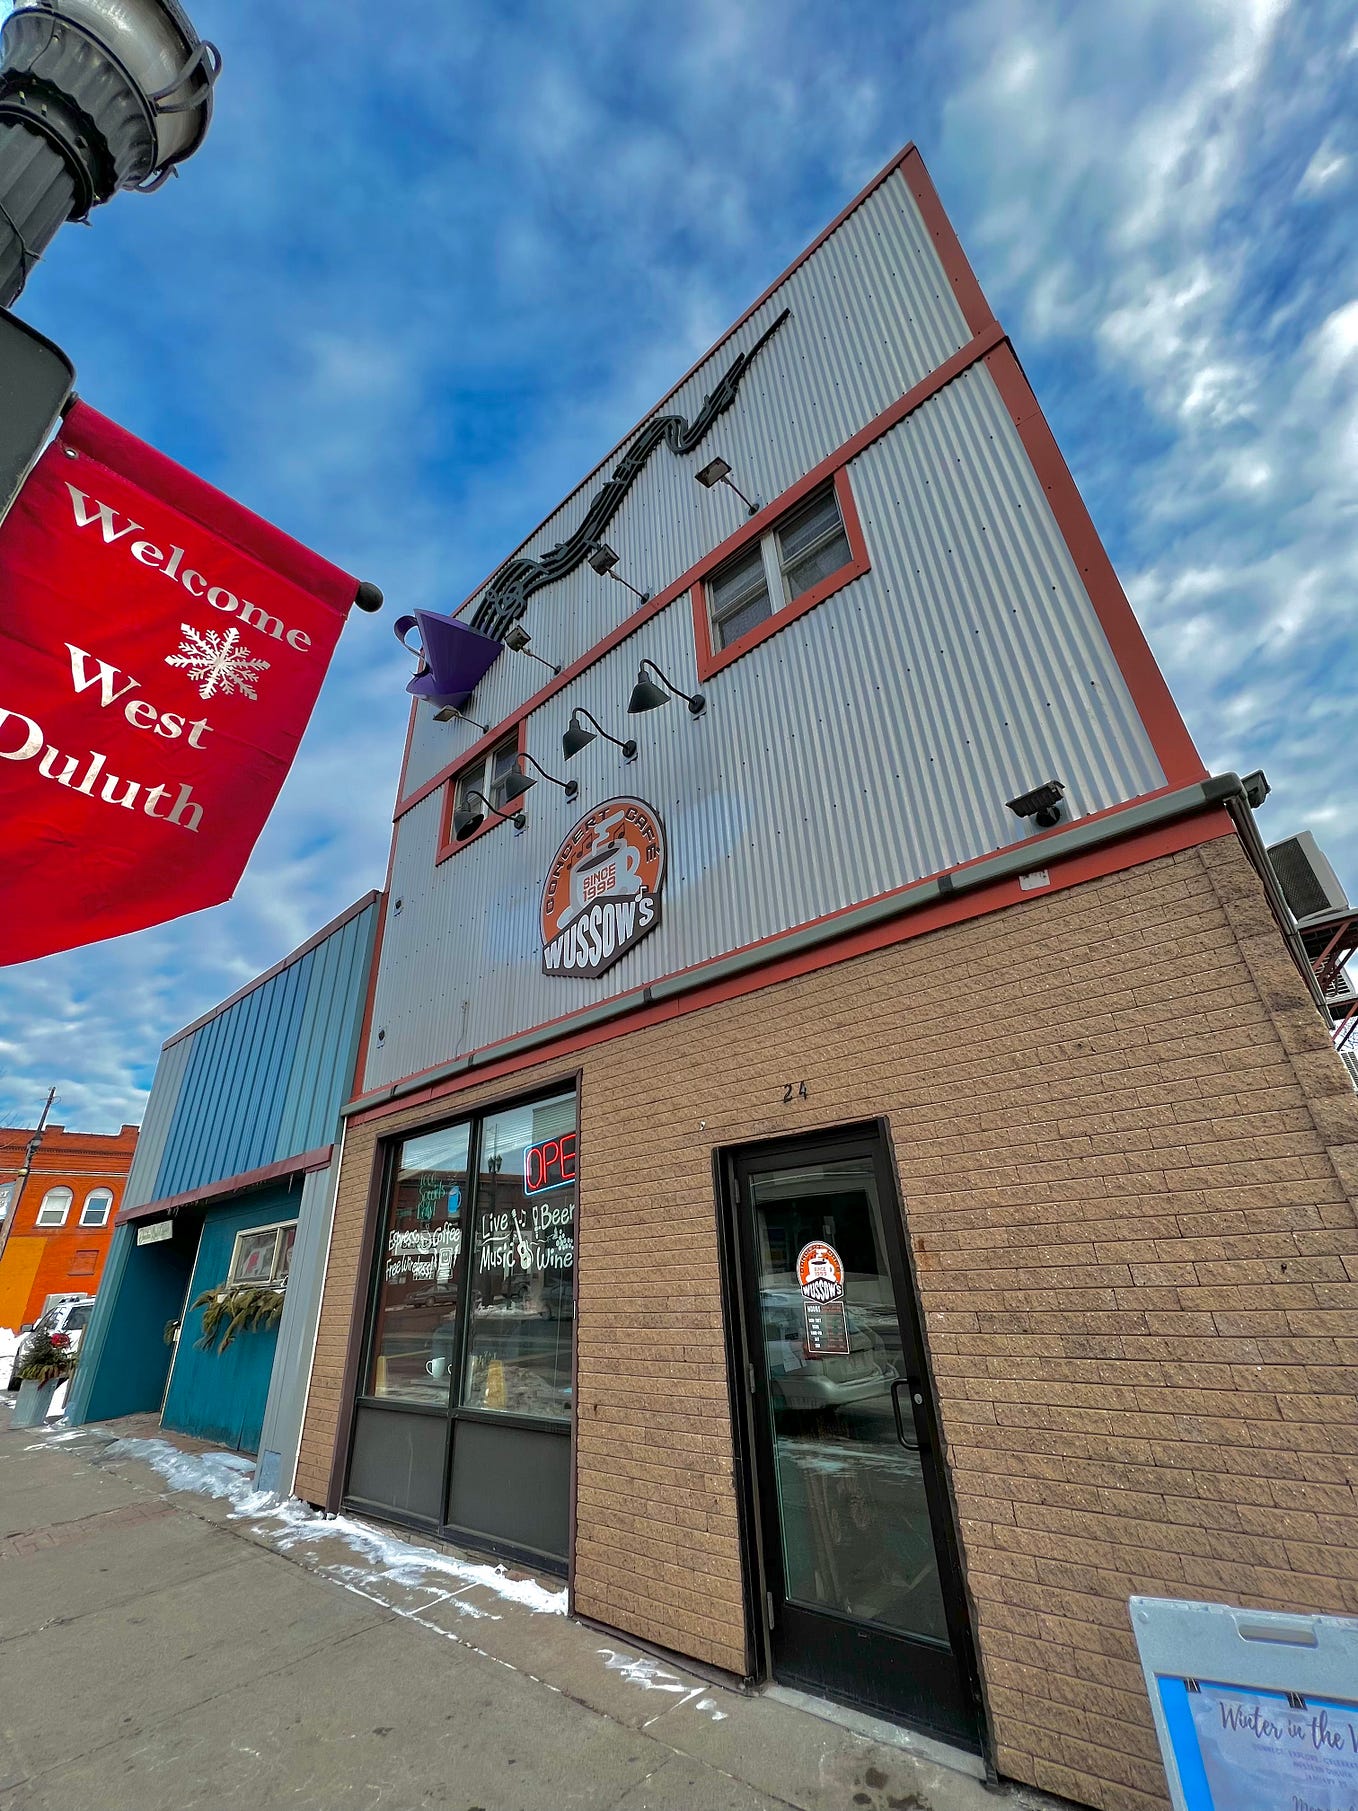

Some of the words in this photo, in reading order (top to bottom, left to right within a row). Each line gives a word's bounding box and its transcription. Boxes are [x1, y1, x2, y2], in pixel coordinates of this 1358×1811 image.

[64, 481, 312, 652] Welcome
[64, 642, 214, 750] West
[0, 709, 205, 833] Duluth
[545, 808, 610, 915] CONCERT
[583, 863, 616, 887] SINCE
[583, 876, 616, 902] 1999
[543, 886, 655, 970] WUSSOW'S
[784, 1080, 807, 1103] 24
[482, 1212, 509, 1239] Live
[540, 1203, 576, 1231] Beer
[432, 1221, 461, 1247] Coffee
[385, 1258, 402, 1282] Free
[480, 1242, 516, 1274] Music
[536, 1247, 574, 1271] Wine
[1219, 1700, 1284, 1740] Winter
[1287, 1720, 1306, 1740] in
[1305, 1709, 1346, 1751] the
